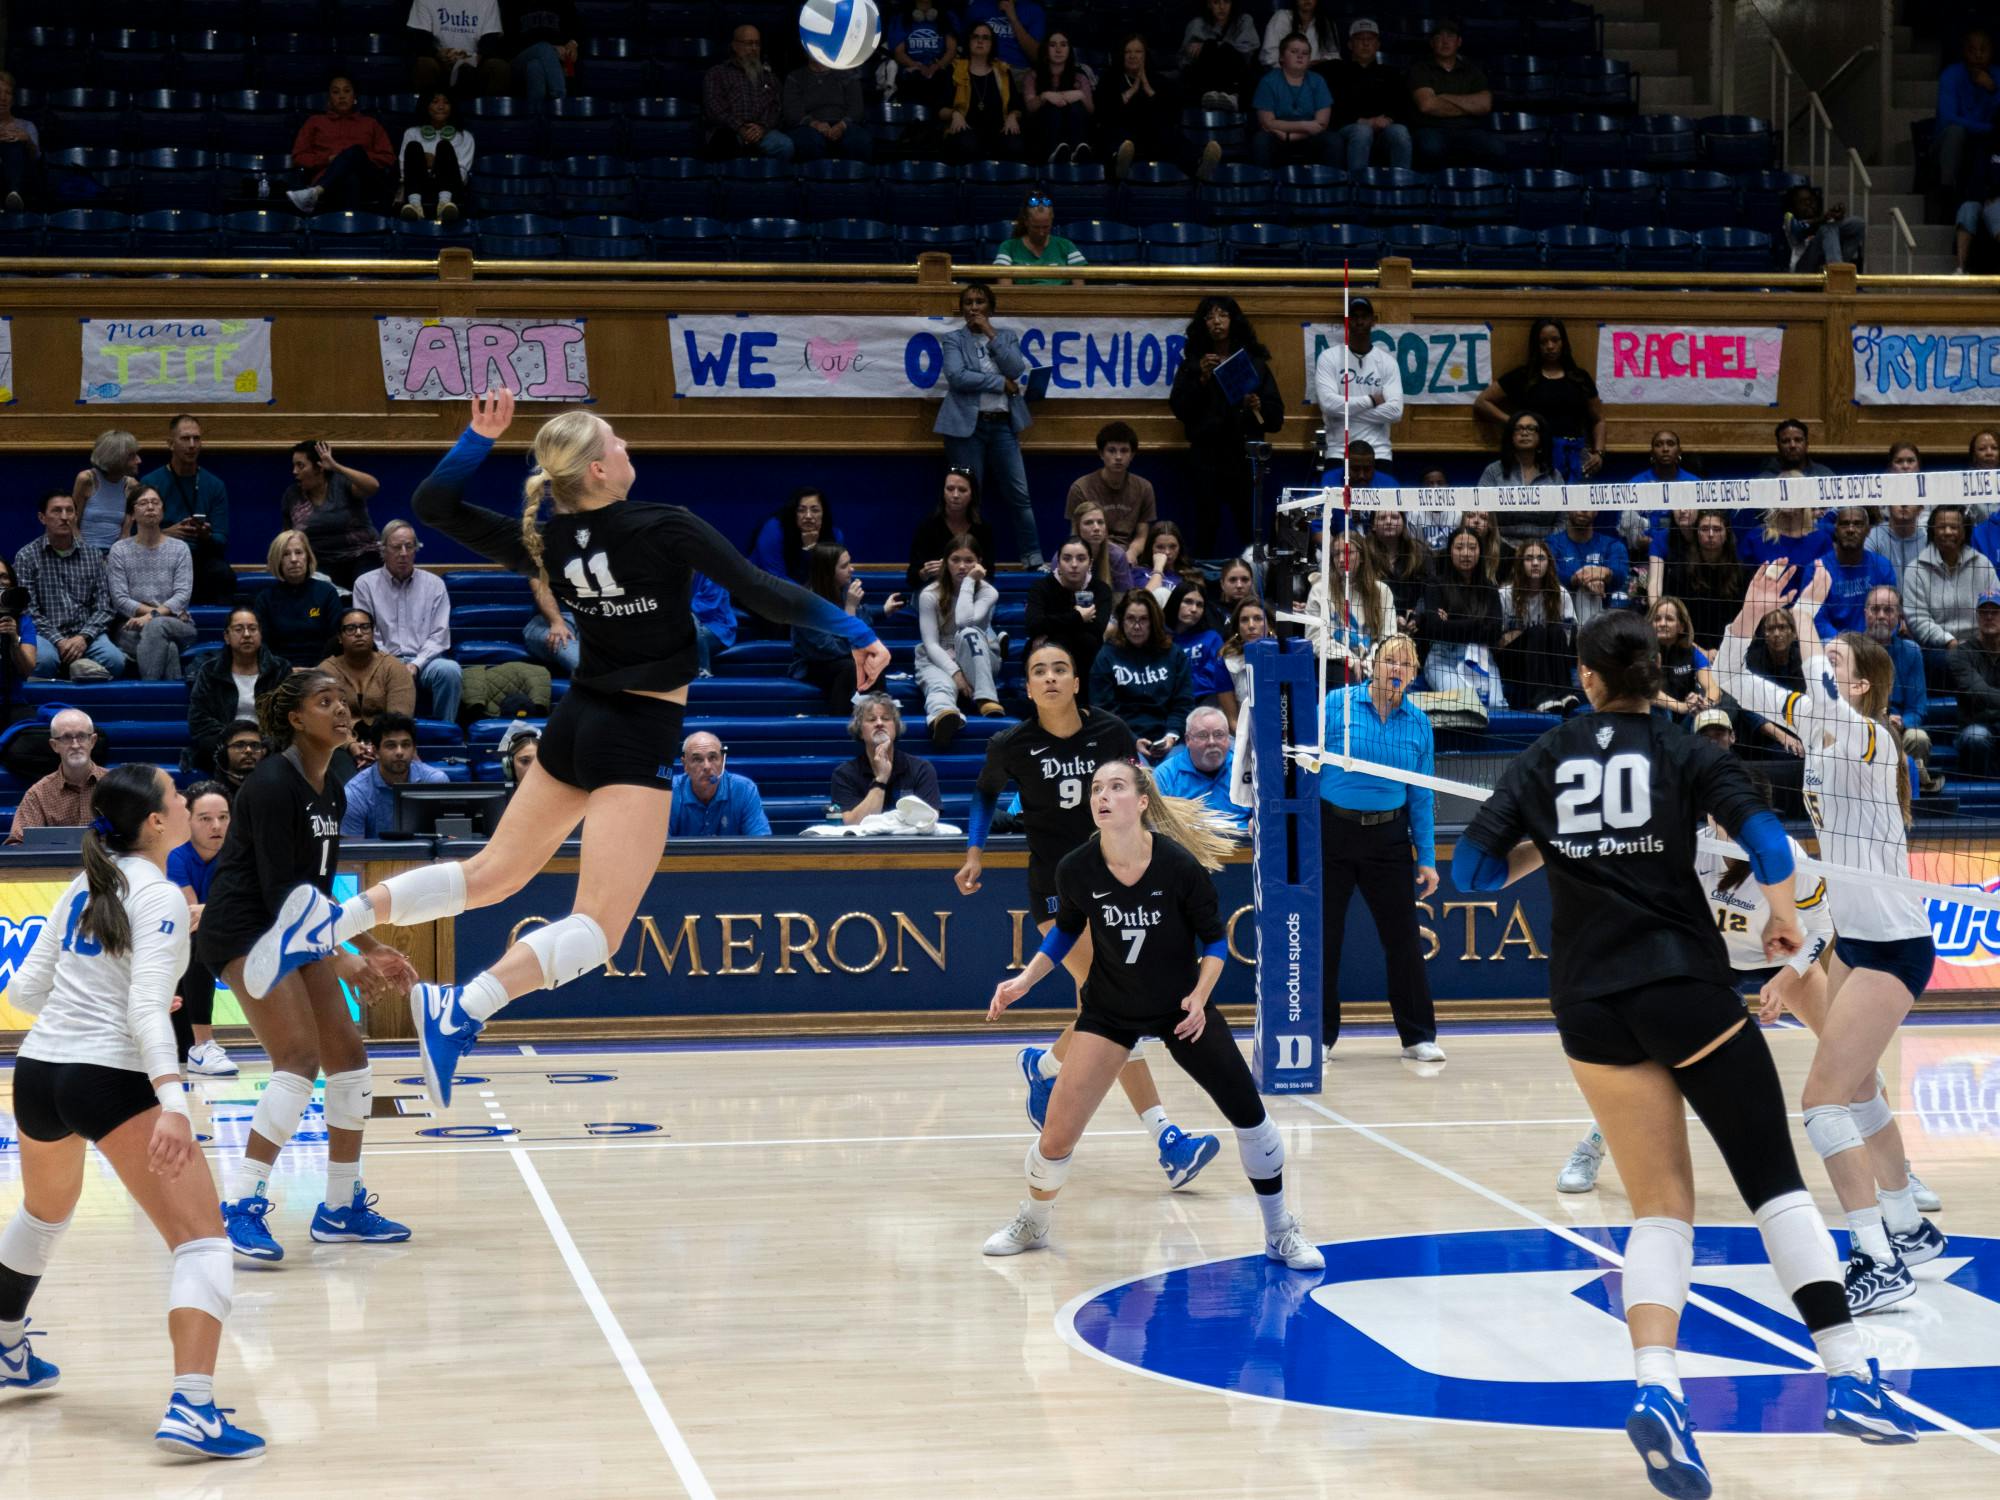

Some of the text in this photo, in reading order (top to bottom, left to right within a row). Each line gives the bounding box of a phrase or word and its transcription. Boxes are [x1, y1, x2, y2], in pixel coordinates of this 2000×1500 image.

[437, 7, 479, 27] Duke
[909, 38, 938, 49] DUKE
[101, 342, 241, 385] TIFF
[404, 324, 590, 398] ARI
[684, 330, 778, 389] WE
[798, 341, 880, 373] love
[1612, 332, 1758, 380] RACHEL
[1339, 368, 1382, 388] Duke
[1499, 487, 1516, 506] BLUE
[1517, 487, 1541, 506] DEVILS
[1590, 485, 1609, 505] BLUE
[1611, 484, 1638, 504] DEVILS
[1696, 482, 1717, 503] BLUE
[1720, 480, 1750, 502] DEVILS
[1818, 477, 1843, 500] BLUE
[1847, 475, 1882, 499] DEVILS
[1962, 471, 1992, 497] BLUE
[564, 551, 625, 598] 11
[599, 596, 658, 617] Devils
[1112, 664, 1169, 686] Duke
[1040, 755, 1096, 780] Duke
[1059, 779, 1082, 809] 9
[1555, 753, 1652, 835] 20
[310, 815, 338, 838] Duke
[319, 839, 330, 876] 1
[1598, 835, 1664, 857] Devils
[1710, 889, 1757, 911] California
[1101, 904, 1162, 927] Duke
[1717, 908, 1747, 932] 12
[505, 911, 952, 977] MERON
[1121, 929, 1146, 964] 7
[1286, 913, 1302, 1022] sports imports
